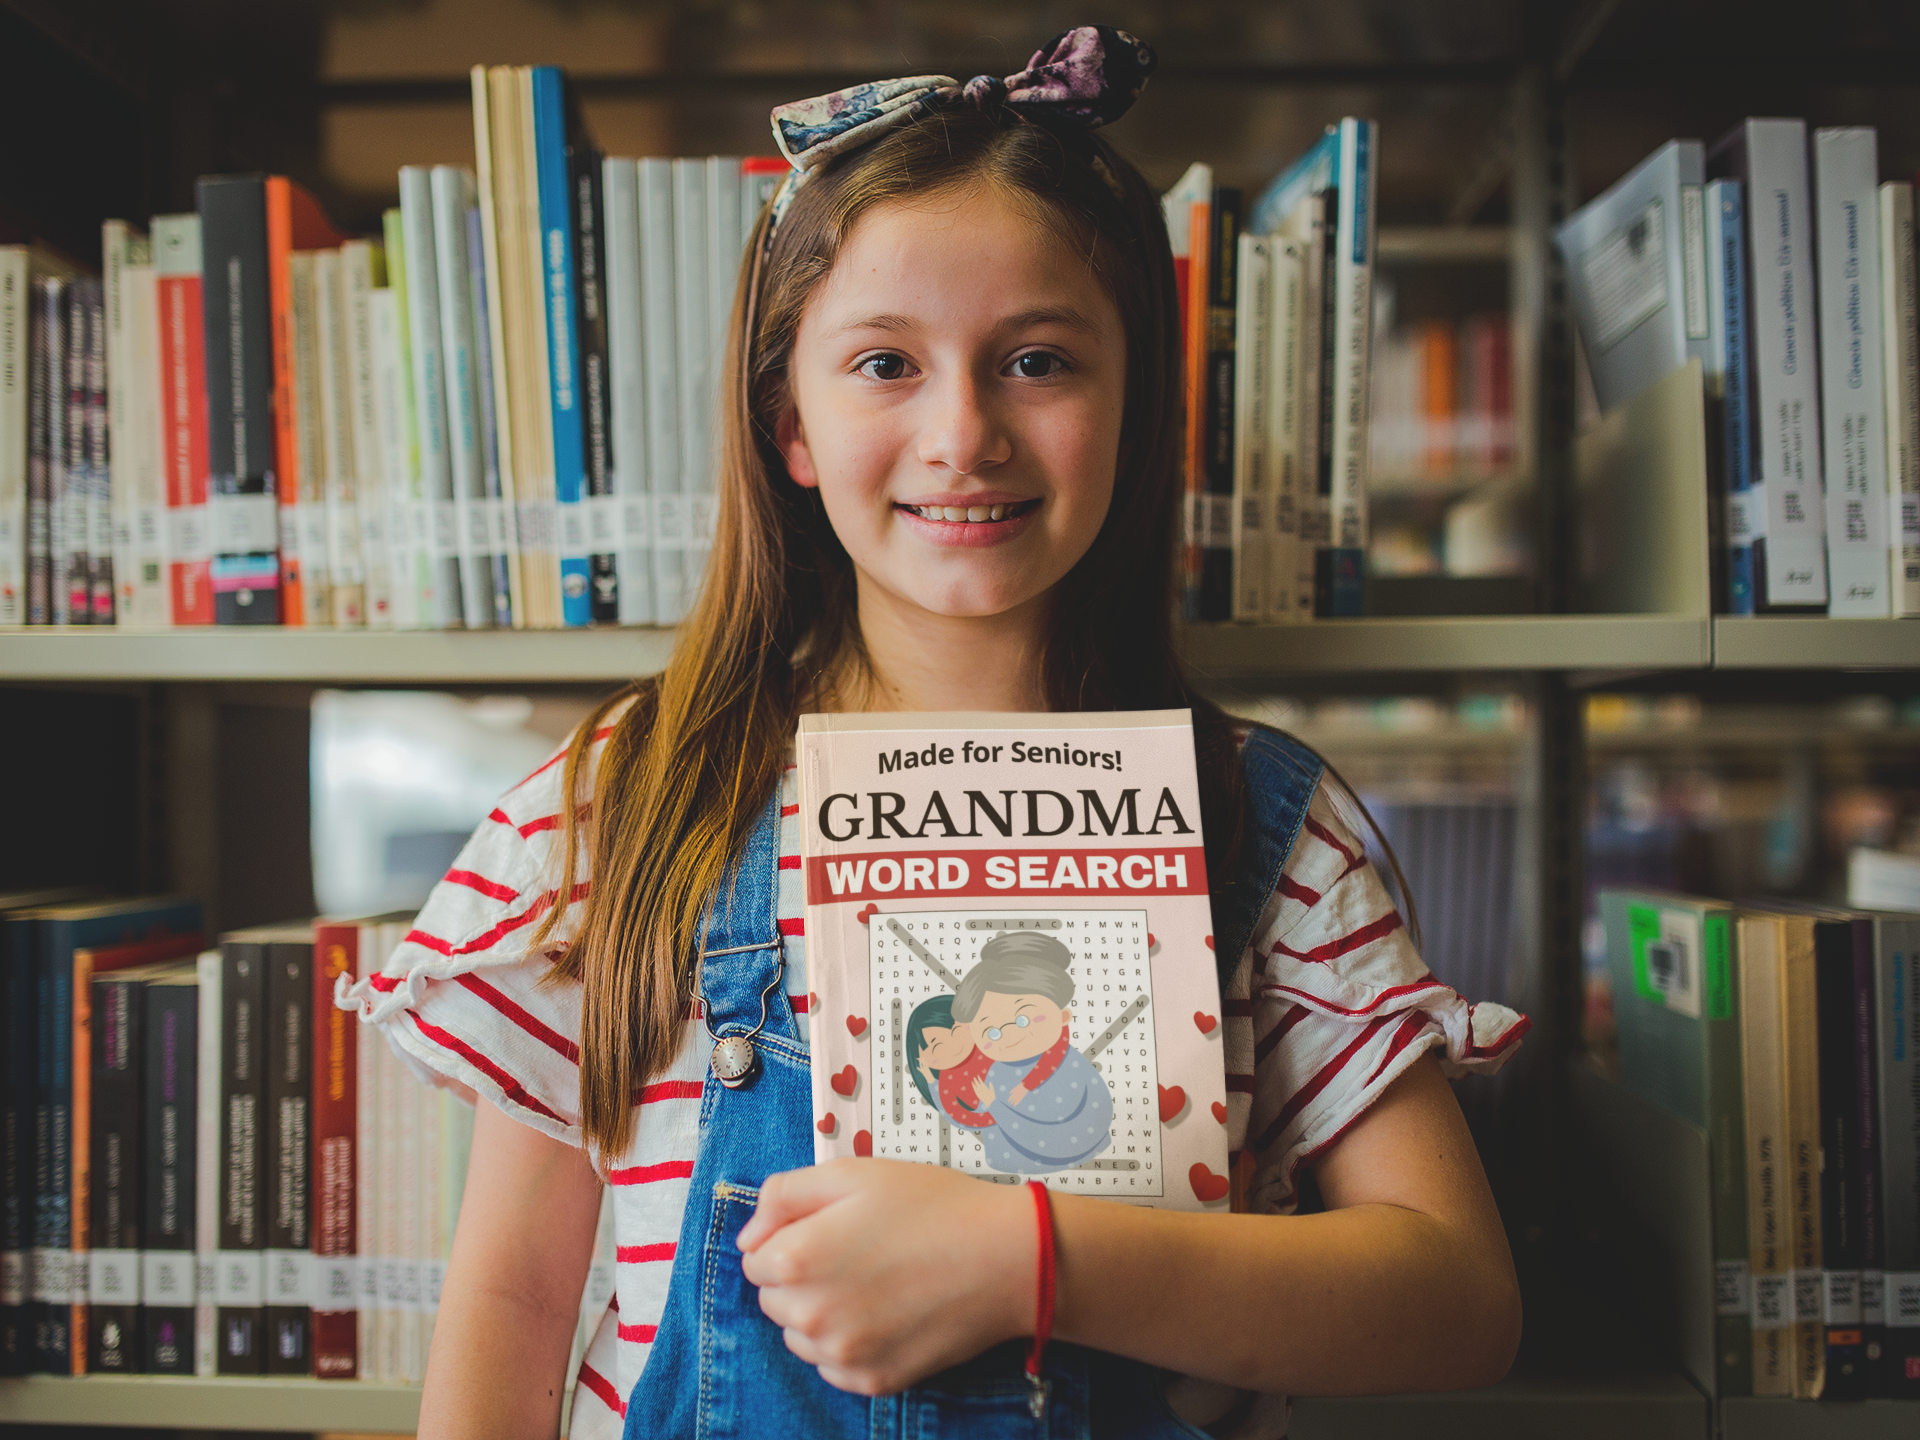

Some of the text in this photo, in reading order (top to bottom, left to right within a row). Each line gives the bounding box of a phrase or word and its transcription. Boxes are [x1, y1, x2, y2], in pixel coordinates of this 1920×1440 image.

[878, 741, 1123, 775] Made for Seniors!
[818, 787, 1195, 842] GRANDMA
[826, 854, 1188, 895] WORD SEARCH
